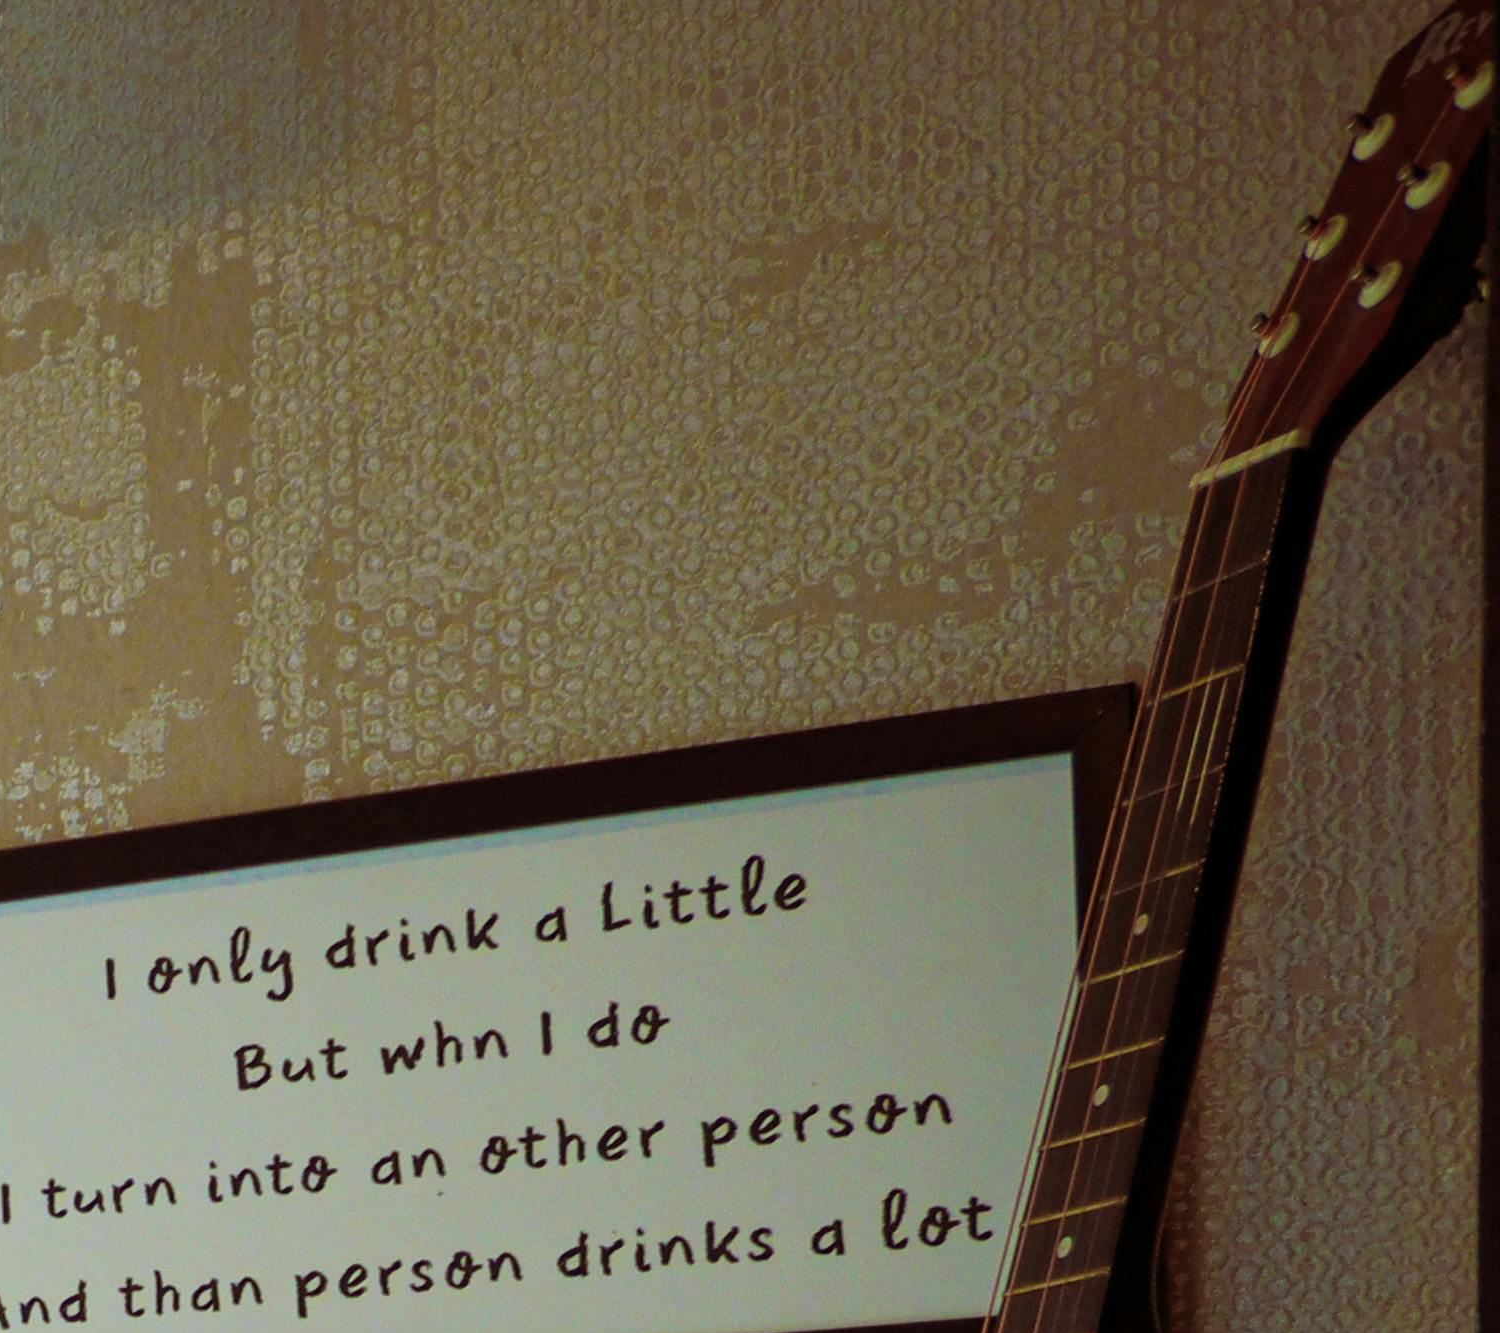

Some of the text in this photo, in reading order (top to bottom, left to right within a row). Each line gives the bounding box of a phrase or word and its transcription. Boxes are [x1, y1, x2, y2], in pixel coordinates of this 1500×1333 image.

[104, 853, 808, 1004] I only drink a Little
[232, 999, 672, 1093] But whn I do
[0, 1092, 955, 1226] I turn into an other person
[116, 1268, 265, 1319] than
[293, 1249, 525, 1320] person
[555, 1219, 776, 1279] drinks
[809, 1217, 847, 1258] a
[880, 1186, 995, 1252] lot
